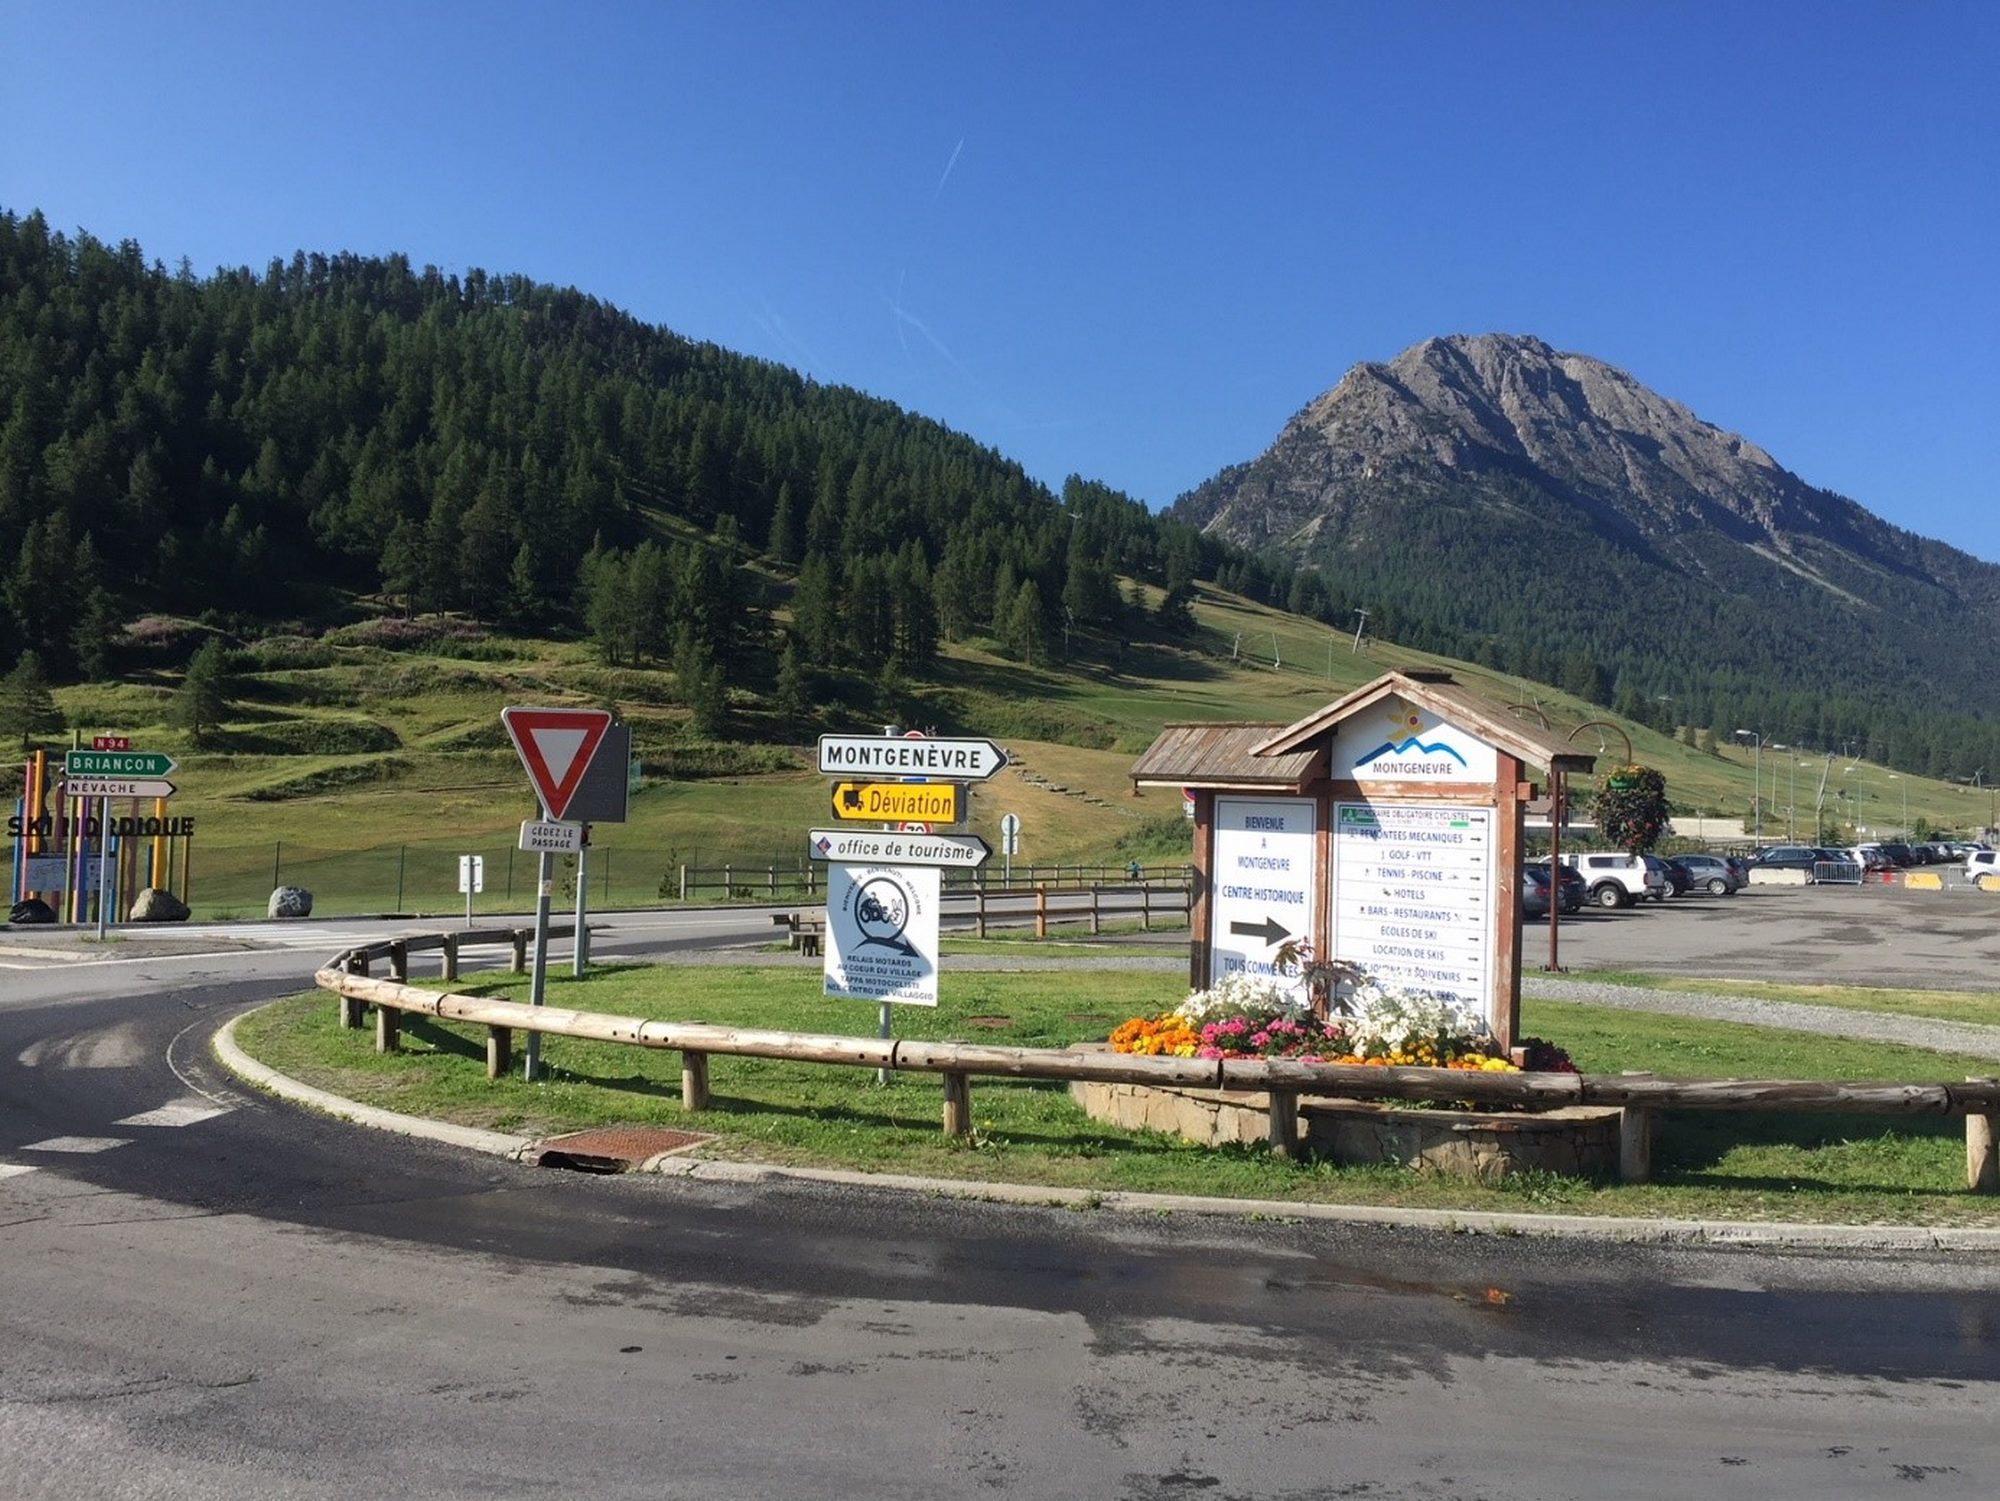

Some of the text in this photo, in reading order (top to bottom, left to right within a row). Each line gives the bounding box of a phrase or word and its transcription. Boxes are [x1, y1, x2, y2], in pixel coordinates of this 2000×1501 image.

[97, 739, 125, 749] N 94
[828, 745, 981, 768] MONTGENÈVRE
[72, 757, 156, 771] BRIANÇON
[1373, 762, 1453, 775] MONTGENEVRE
[71, 781, 137, 794] NÉVACHE
[870, 790, 952, 815] Déviation
[7, 816, 53, 837] SKI
[1244, 816, 1285, 830] BIENVENUE
[563, 829, 574, 838] LE
[531, 838, 571, 848] PASSAGE
[838, 839, 974, 859] office de tourisme
[1389, 849, 1410, 860] GOLF
[1416, 851, 1432, 861] VTT
[1377, 867, 1406, 878] TENNIS
[1411, 869, 1443, 881] PISCINE
[1222, 885, 1304, 904] CENTRE HISTORIQUE
[1393, 888, 1426, 900] HOTELS
[1367, 905, 1388, 916] BARS
[1394, 907, 1452, 921] RESTAURANTS
[1411, 928, 1422, 939] DE
[1373, 943, 1445, 960] LOCATION DE SKIS
[847, 955, 912, 967] RELAIS MOTARDS
[1223, 957, 1246, 972] TOUS
[876, 966, 888, 975] DU
[889, 967, 922, 977] VILLAGE
